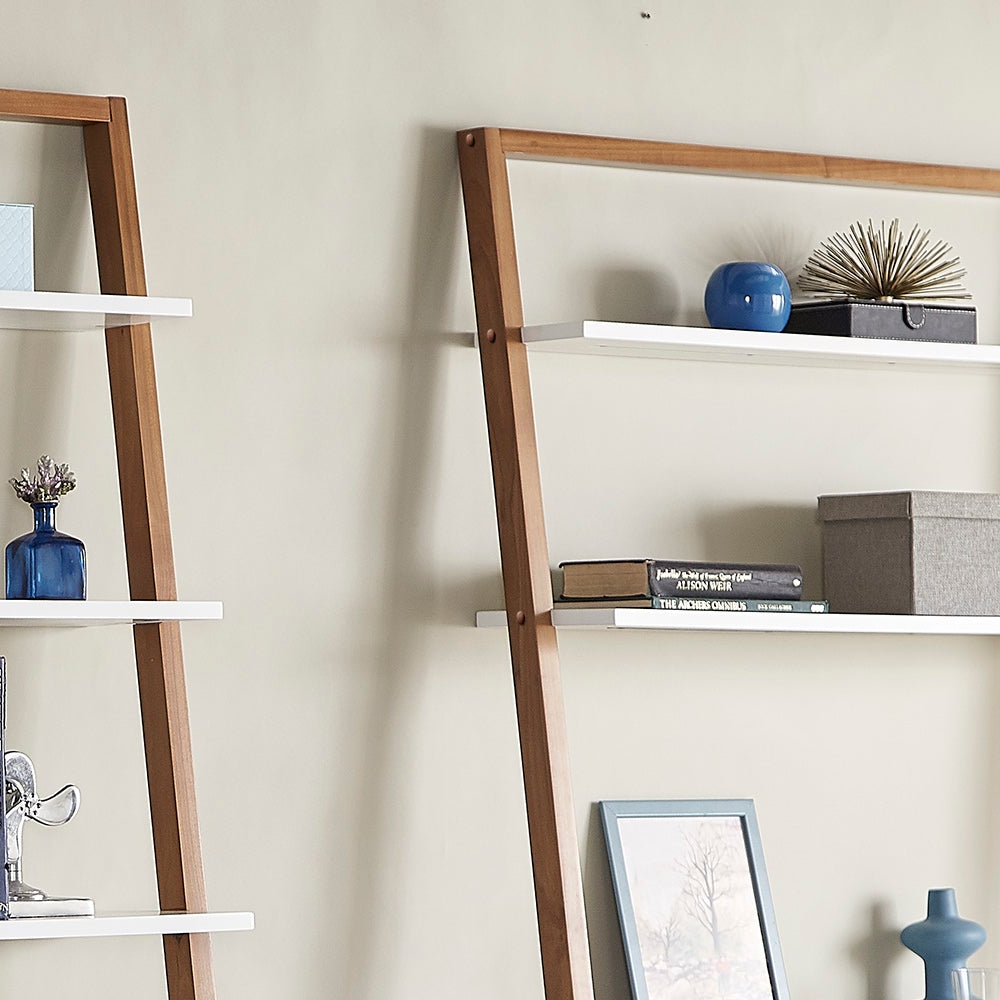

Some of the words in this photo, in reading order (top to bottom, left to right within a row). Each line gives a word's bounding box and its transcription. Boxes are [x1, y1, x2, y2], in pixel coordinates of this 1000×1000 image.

[676, 580, 708, 591] ALISON
[710, 581, 732, 592] WEIR
[660, 600, 676, 609] THE
[678, 600, 711, 610] ARCHERS
[712, 601, 746, 611] OMNIBUS
